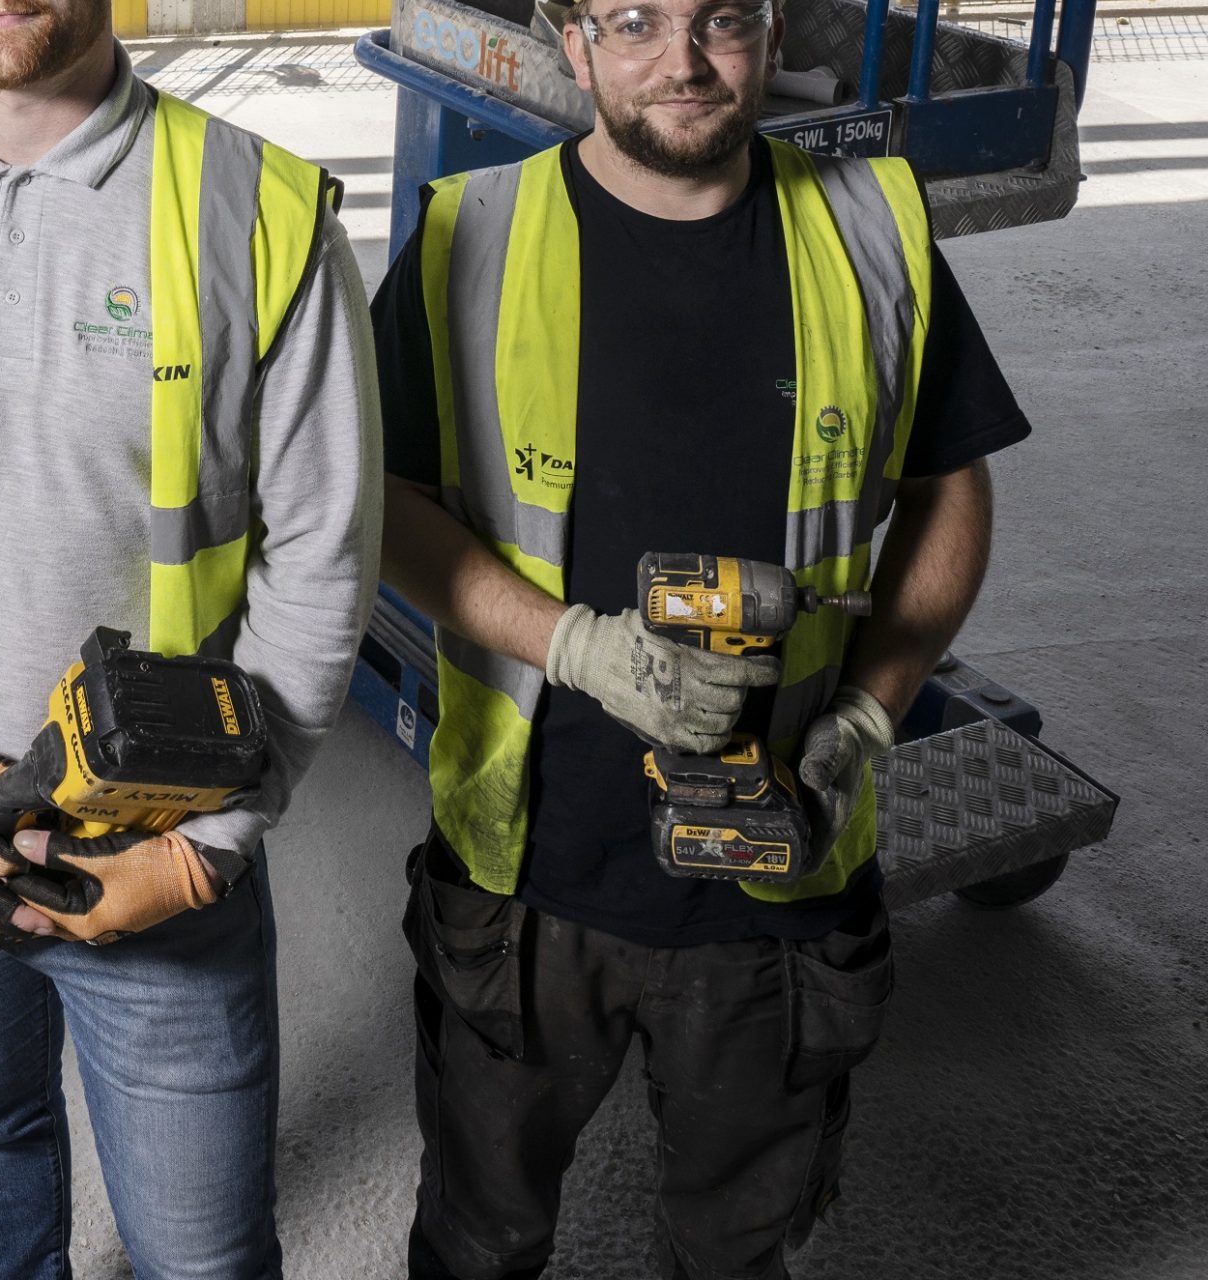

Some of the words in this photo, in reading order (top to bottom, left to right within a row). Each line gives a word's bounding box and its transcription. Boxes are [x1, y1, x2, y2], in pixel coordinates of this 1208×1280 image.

[413, 10, 520, 92] ecolift
[794, 128, 828, 148] SWL
[836, 121, 884, 143] 150kg
[74, 321, 113, 335] Clear
[117, 326, 153, 340] Clima
[153, 364, 191, 382] KIN
[793, 455, 825, 466] Clear
[61, 678, 73, 724] CLEAR
[676, 847, 696, 856] 54V
[697, 841, 725, 858] XR
[724, 844, 754, 853] FLEX
[765, 855, 785, 864] 18V
